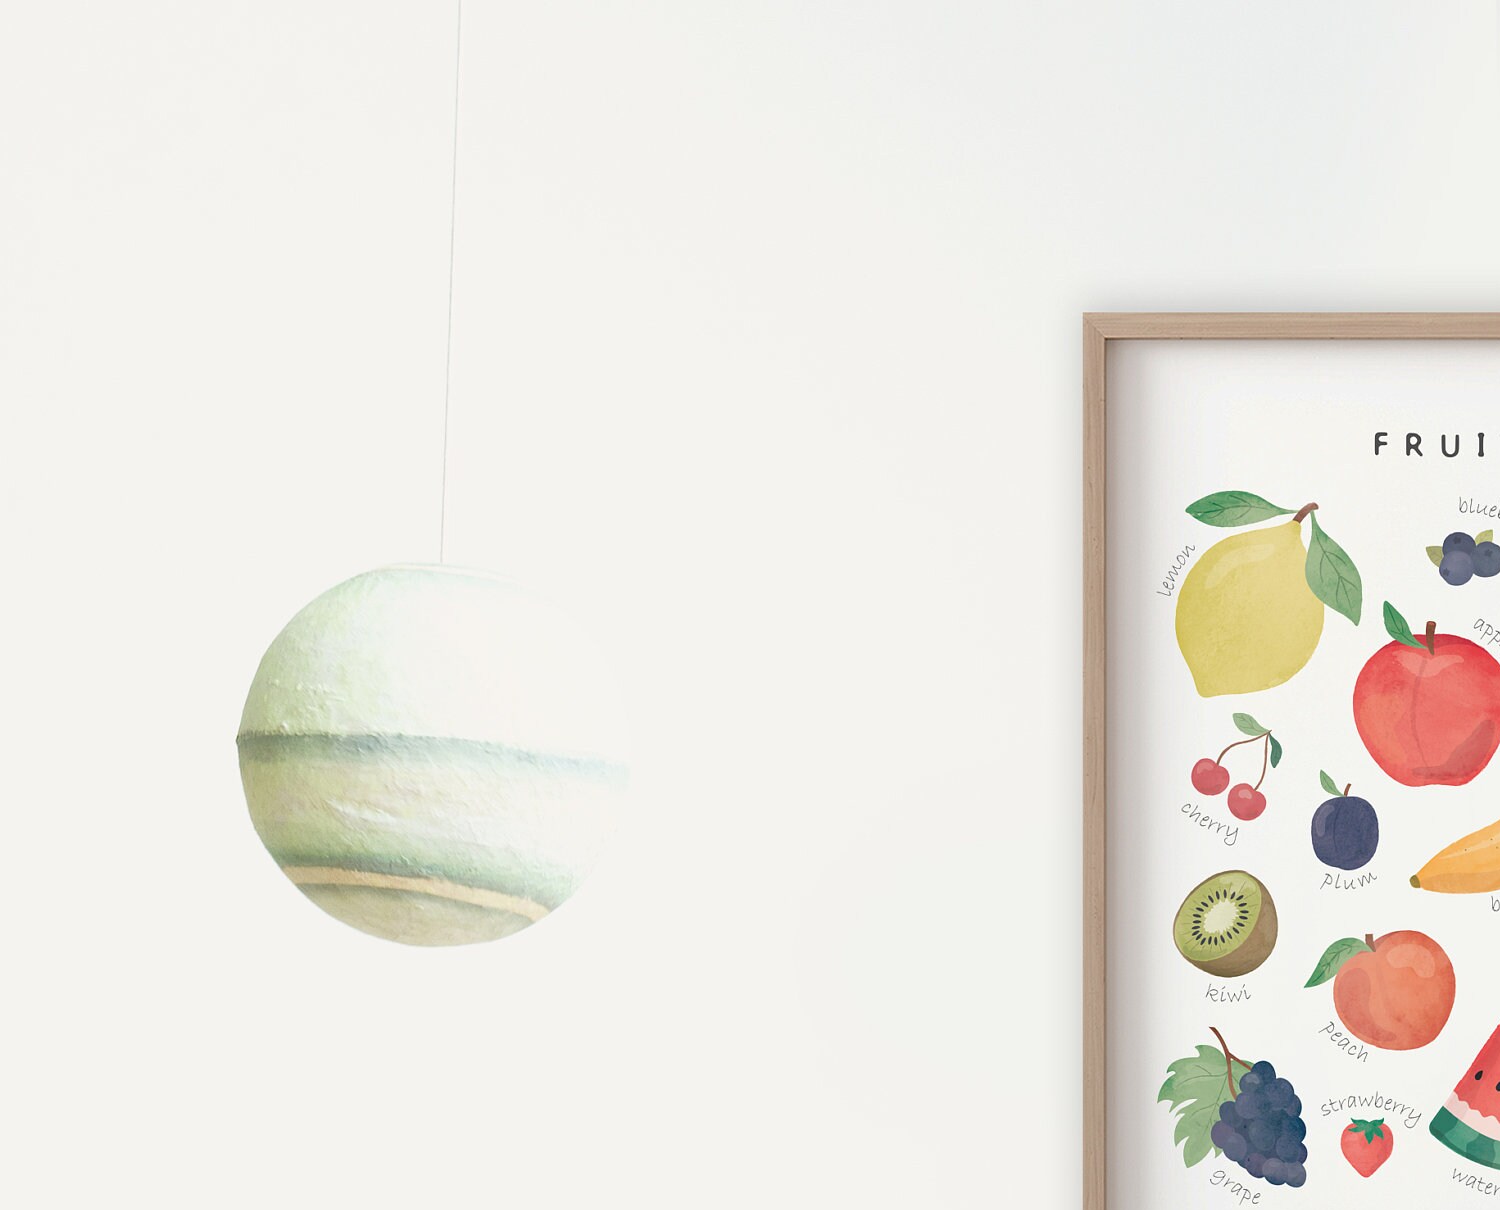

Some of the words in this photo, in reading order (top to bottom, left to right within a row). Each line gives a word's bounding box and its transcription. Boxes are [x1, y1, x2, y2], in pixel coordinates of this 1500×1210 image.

[1156, 544, 1196, 598] lemon
[1180, 802, 1240, 846] cherry
[1319, 872, 1378, 890] plum
[1205, 983, 1252, 1003] kiwi
[1318, 1020, 1370, 1063] peach
[1320, 1090, 1423, 1129] strawberry
[1208, 1168, 1262, 1206] grape
